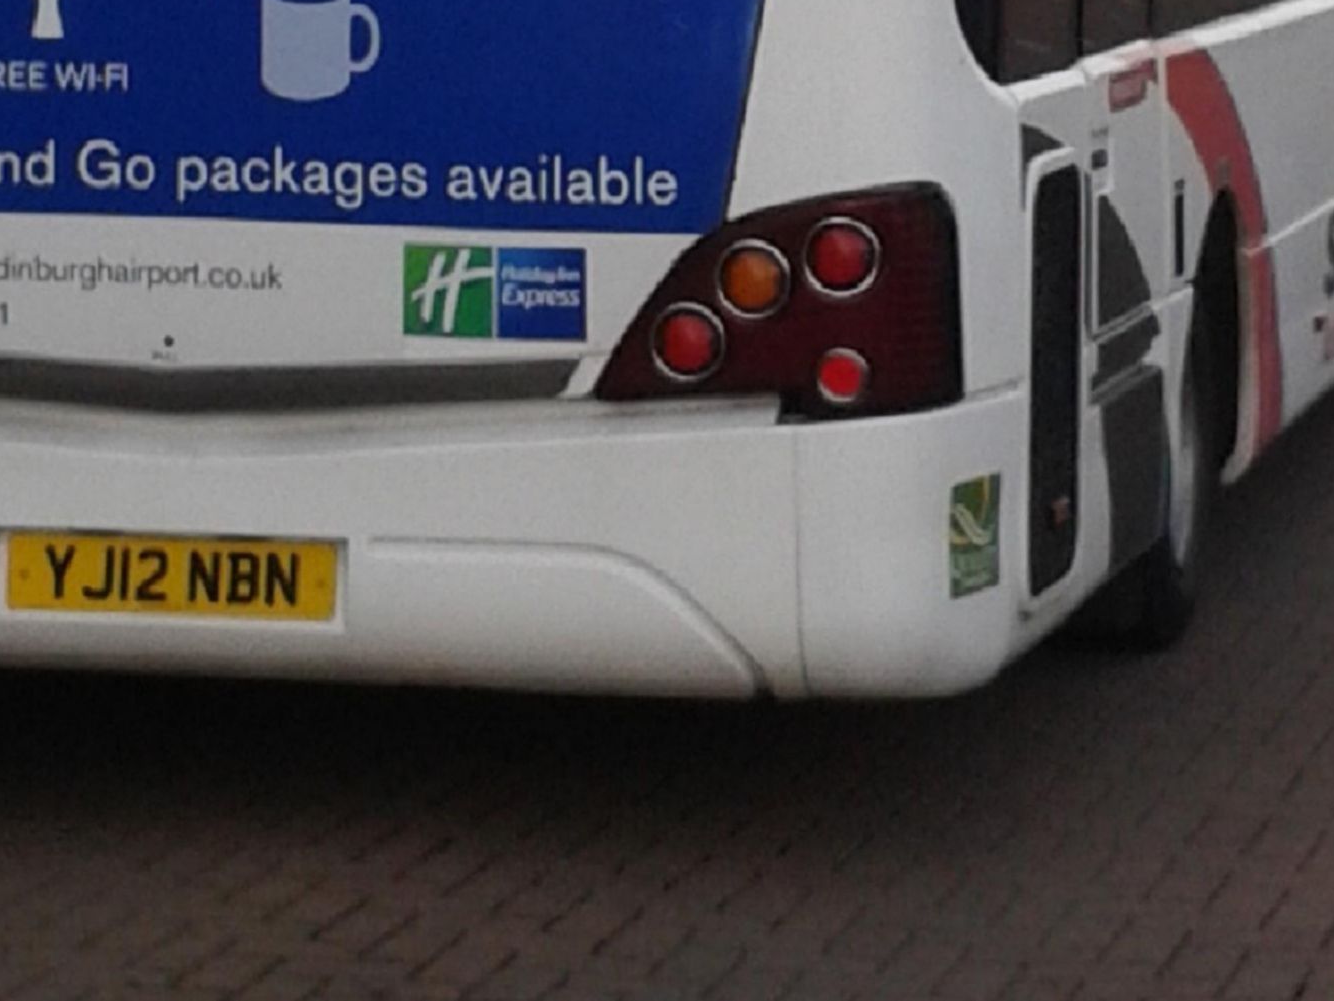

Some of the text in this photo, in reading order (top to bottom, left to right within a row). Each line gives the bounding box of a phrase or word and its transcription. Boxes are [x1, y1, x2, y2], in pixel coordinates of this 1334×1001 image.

[77, 138, 157, 192] Go
[174, 145, 428, 210] packages
[445, 155, 679, 206] available
[500, 283, 581, 310] Express
[44, 544, 302, 607] YJ12 NBN
